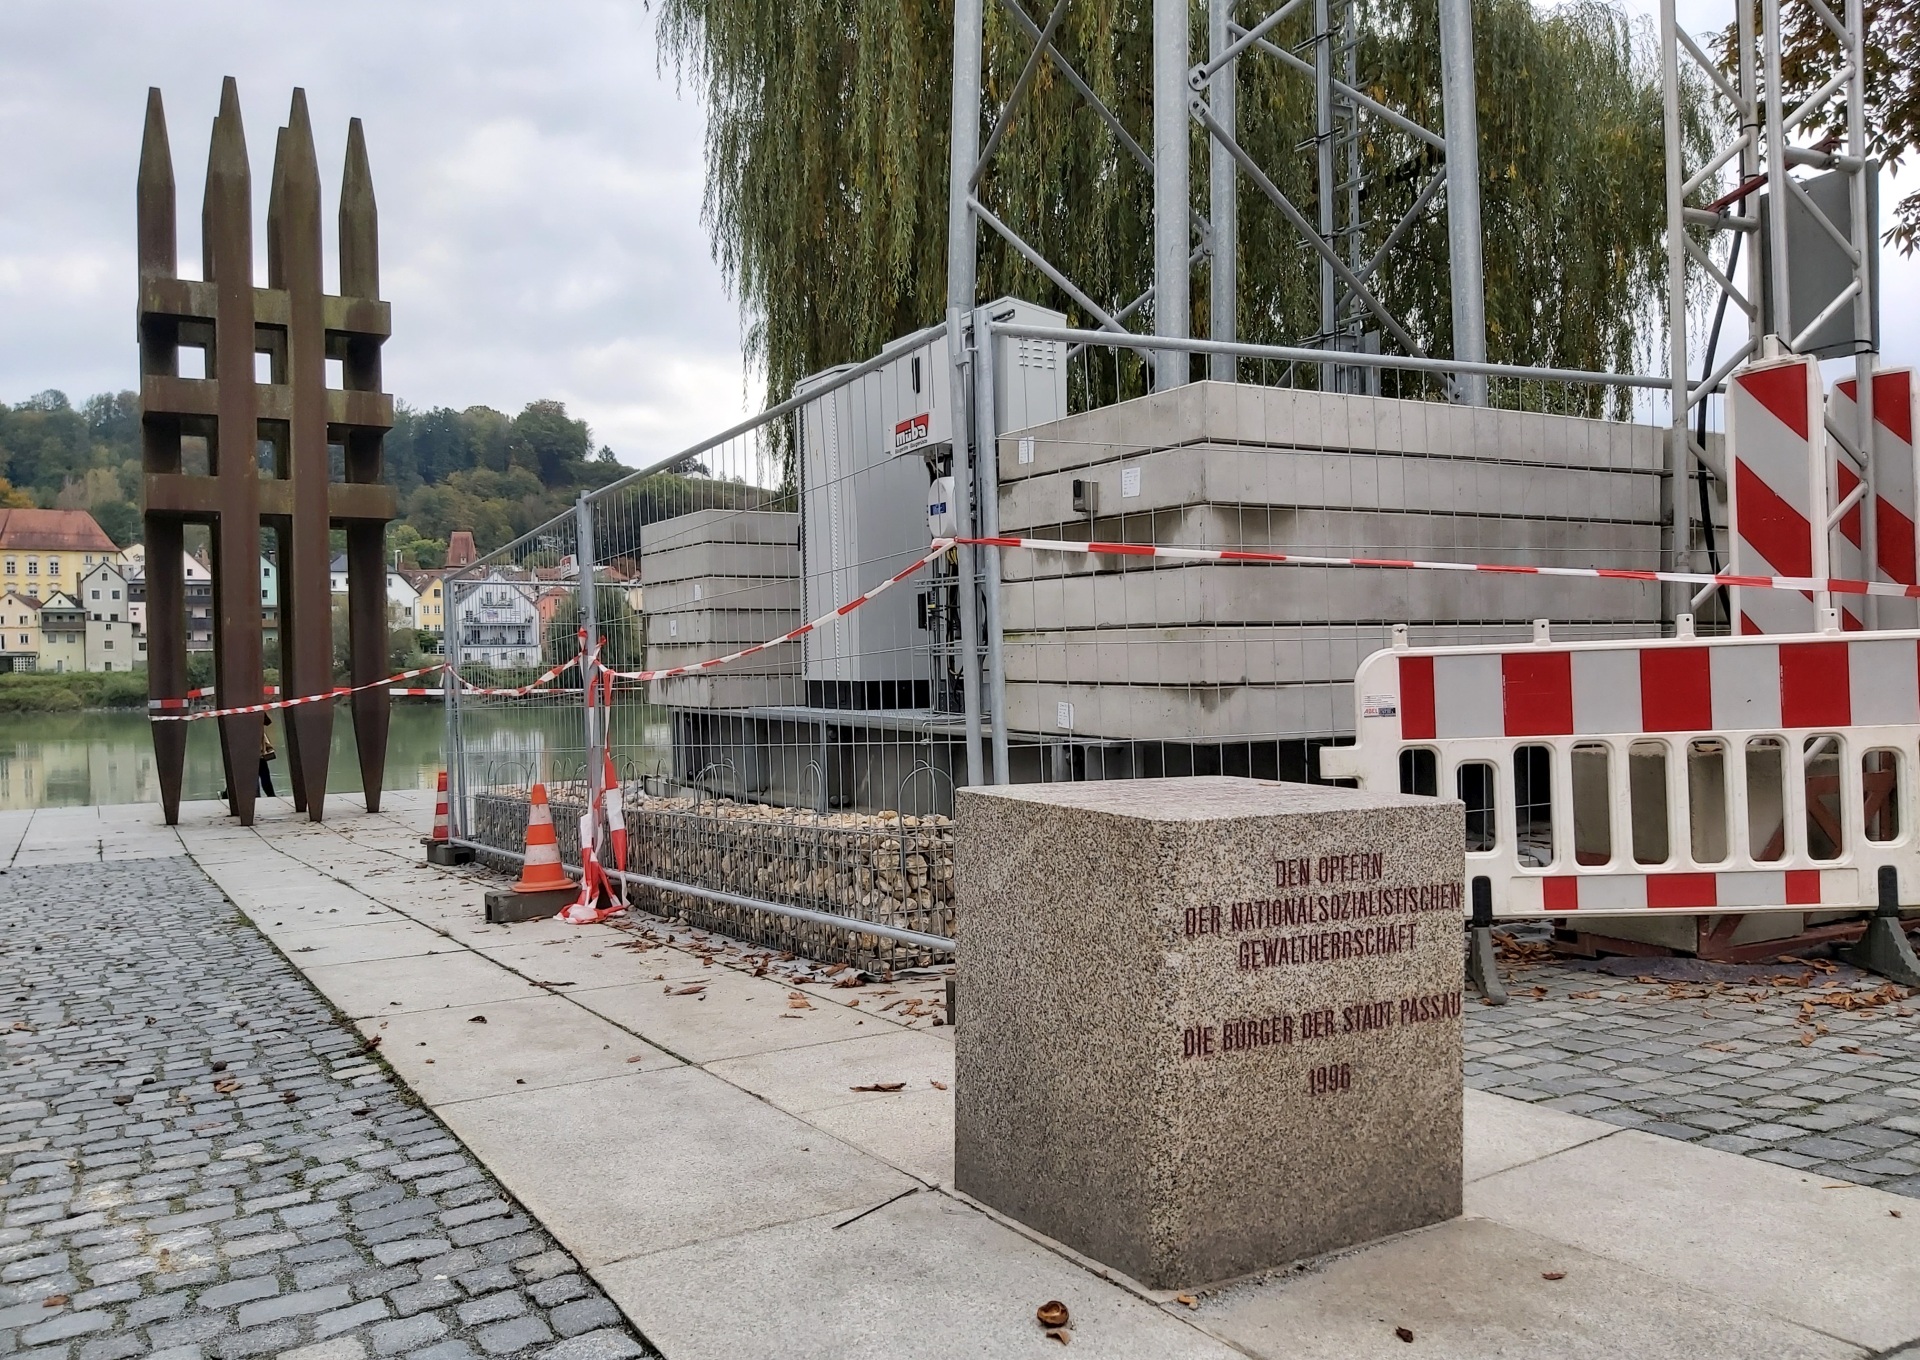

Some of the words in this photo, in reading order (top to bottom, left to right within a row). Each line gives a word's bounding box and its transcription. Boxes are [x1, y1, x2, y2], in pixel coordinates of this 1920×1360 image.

[896, 419, 928, 447] müba
[1275, 858, 1310, 888] DEN
[1318, 853, 1383, 885] OPFERN
[1185, 905, 1220, 936] DER
[1231, 883, 1461, 932] NATIONALSOZIALISTISCHEN
[1239, 924, 1416, 969] GEWALTHERRSCHAFT
[1184, 1027, 1214, 1059] DIE
[1301, 1010, 1335, 1040] DER
[1343, 1001, 1394, 1033] STADT
[1400, 992, 1462, 1026] PASSAU
[1308, 1063, 1350, 1096] 1996
